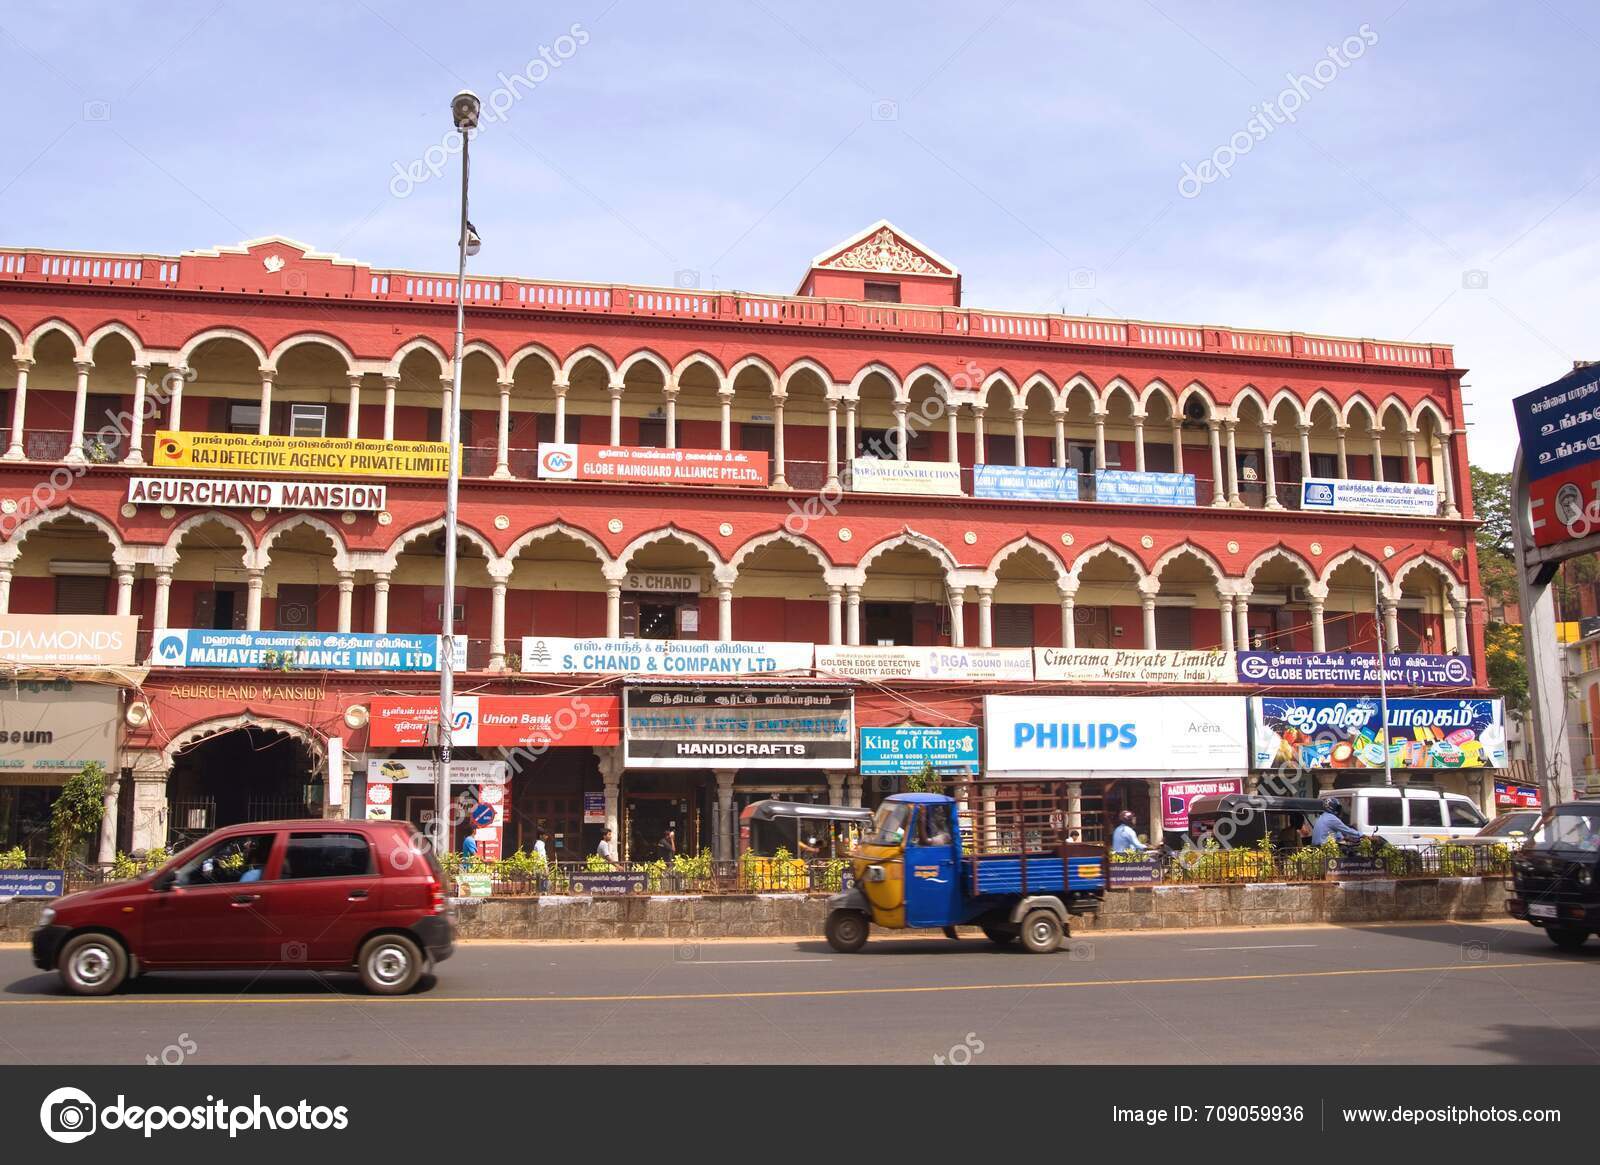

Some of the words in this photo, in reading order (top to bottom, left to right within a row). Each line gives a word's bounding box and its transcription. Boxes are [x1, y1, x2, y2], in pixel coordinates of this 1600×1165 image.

[192, 448, 218, 464] RAJ
[220, 450, 286, 467] DETECTIVE
[289, 452, 346, 468] AGENCY
[350, 454, 404, 470] PRIVATE
[405, 457, 449, 473] LIMITE
[583, 462, 614, 475] GLOBE
[617, 463, 672, 477] MAINGUARD
[674, 466, 719, 479] ALLIANCE
[132, 480, 272, 506] AGURCHAND
[282, 484, 383, 508] MANSION
[630, 575, 643, 589] S.
[645, 575, 692, 590] CHAND
[0, 630, 123, 651] DIAMONDS
[283, 650, 350, 666] INANCE
[356, 651, 401, 667] INDIA
[406, 651, 433, 668] LTD
[562, 654, 578, 670] S.
[583, 655, 641, 671] CHAND
[646, 656, 658, 671] &
[663, 656, 742, 673] COMPANY
[747, 657, 777, 672] LTD
[821, 659, 853, 667] GOLDEN
[855, 659, 876, 667] EDGE
[878, 660, 921, 668] DETECTIVE
[971, 659, 1002, 668] SOUND
[1004, 659, 1031, 668] IMAGE
[1044, 649, 1109, 667] Cinerama
[1114, 649, 1167, 668] Private
[1171, 649, 1228, 668] Limited
[839, 667, 878, 675] SECURITY
[880, 668, 912, 676] AGENCY
[1268, 668, 1303, 680] GLOBE
[1305, 669, 1361, 681] DETECTIVE
[1363, 669, 1404, 681] AGENCY
[170, 685, 258, 700] AGURCHAND
[262, 685, 326, 700] MANSION
[482, 713, 518, 724] Union
[520, 713, 552, 724] Bank
[1287, 702, 1375, 734] ஆவின்
[865, 735, 900, 753] King
[903, 735, 919, 749] of
[922, 735, 962, 753] Kings
[1014, 722, 1138, 749] PHILIPS
[677, 743, 806, 755] HANDICRAFTS
[1185, 784, 1217, 795] DISCOUNT
[1218, 782, 1235, 793] SALE
